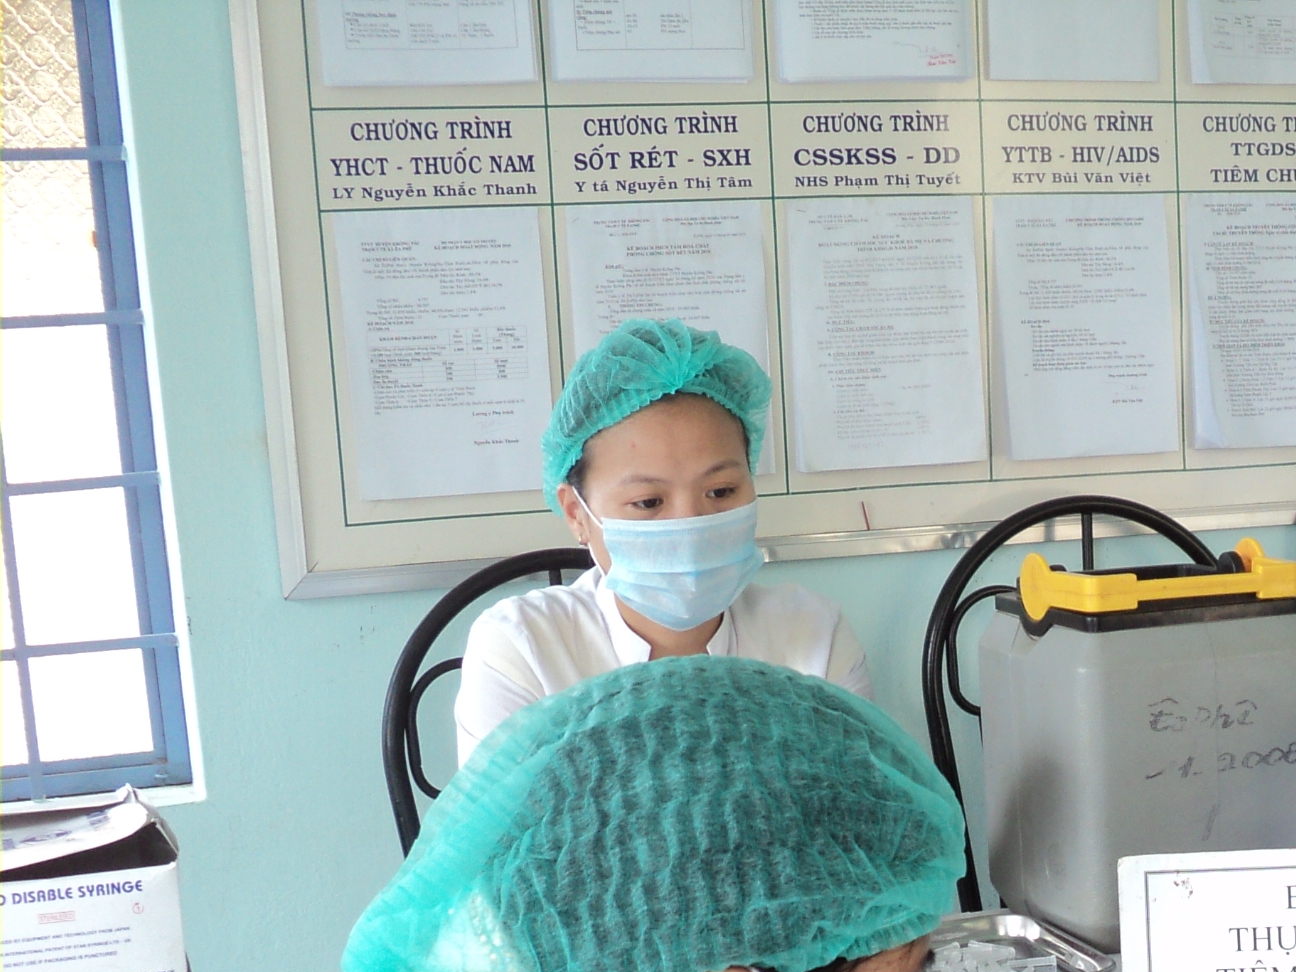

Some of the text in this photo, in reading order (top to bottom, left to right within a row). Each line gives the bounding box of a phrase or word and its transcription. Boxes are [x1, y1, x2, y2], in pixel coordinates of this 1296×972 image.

[350, 116, 512, 142] CHƯƠNG TRÌNH
[583, 111, 739, 137] CHƯƠNG TRÌNH
[803, 110, 950, 133] CHƯƠNG TRÌNH
[1007, 110, 1153, 132] CHƯƠNG TRÌNH
[1203, 113, 1277, 133] CHƯƠNG
[330, 158, 388, 176] YHCT
[410, 147, 482, 175] THUỐC
[489, 155, 536, 173] NAM
[574, 143, 620, 171] SỐT
[629, 145, 679, 170] RÉT
[703, 148, 752, 167] SXH
[793, 147, 897, 167] CSSKSS
[924, 146, 960, 164] DD
[1001, 146, 1052, 163] YTTB
[1072, 145, 1160, 166] HIV/AIDS
[574, 175, 753, 194] Y tá Nguyễn Thị Tâm
[795, 172, 961, 189] NHS Phạm Thị Tuyết
[1012, 172, 1152, 186] KTV Bùi Văn Việt
[1210, 165, 1259, 183] TIÊM
[332, 182, 537, 202] LY Nguyễn Khắc Thanh
[11, 886, 74, 905] DISABLE
[78, 879, 144, 899] SYRINGE
